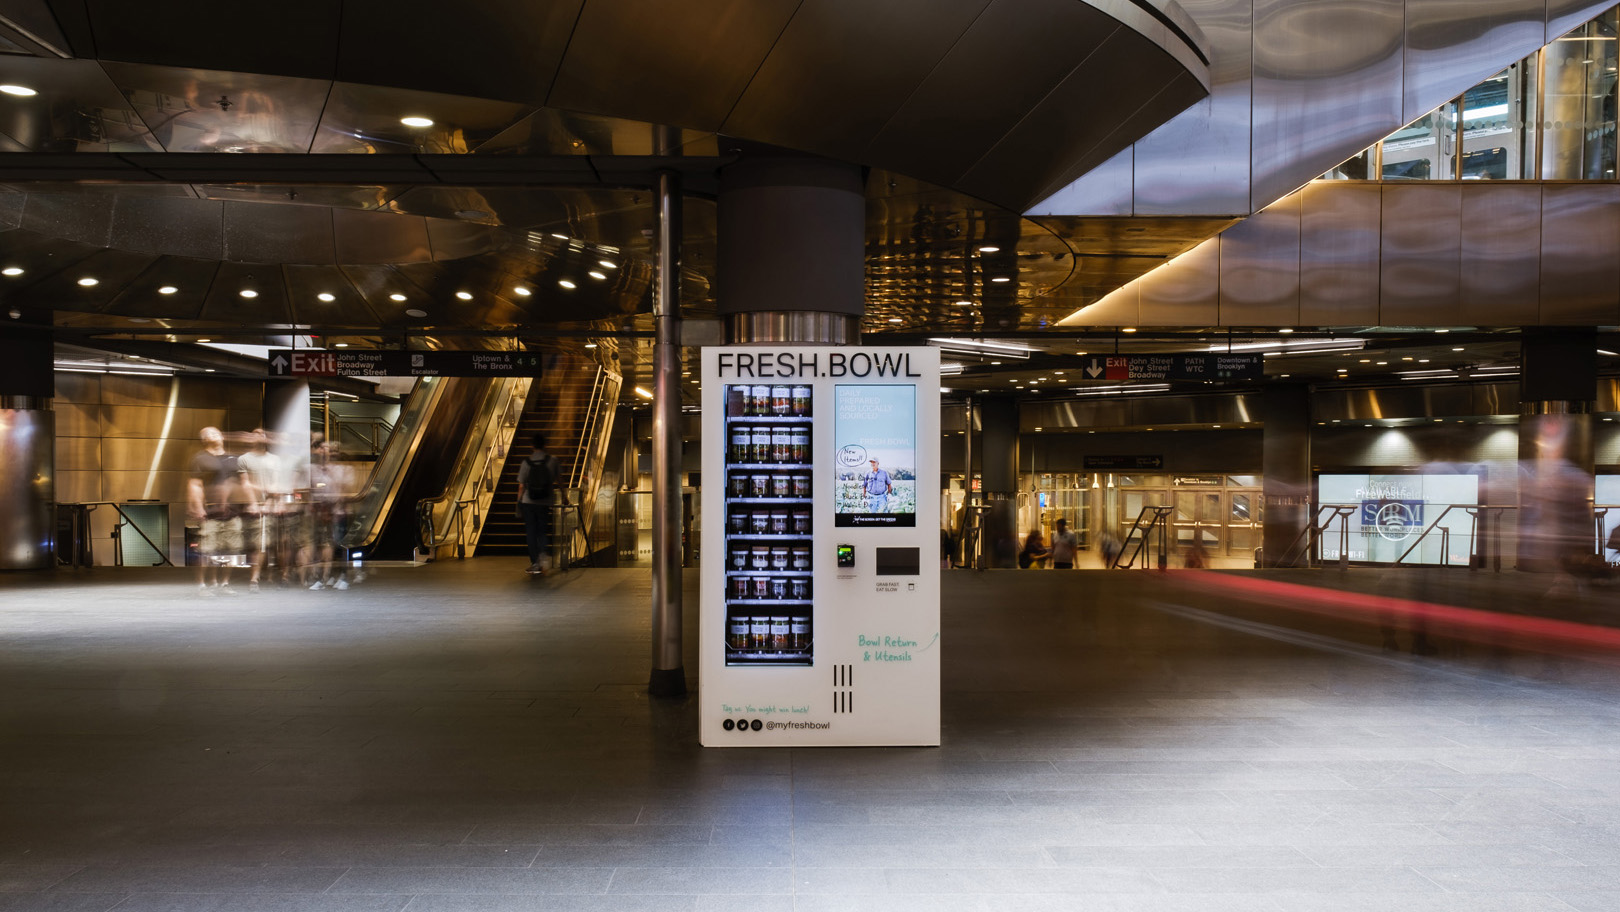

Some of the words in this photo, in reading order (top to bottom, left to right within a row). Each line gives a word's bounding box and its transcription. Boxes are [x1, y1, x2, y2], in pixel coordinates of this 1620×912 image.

[291, 353, 335, 373] Exit
[472, 355, 502, 364] Uptown
[1106, 358, 1127, 367] Exit
[337, 361, 375, 370] Broadway
[492, 362, 513, 370] Bronx
[717, 352, 922, 378] FRESH.BOWL
[840, 397, 881, 405] PREPARED
[840, 412, 878, 420] SOURCED
[859, 635, 880, 647] Bowl
[885, 636, 918, 647] Return
[864, 651, 870, 661] &
[875, 650, 912, 661] Utensils
[722, 704, 733, 713] Tag
[745, 705, 756, 713] You
[759, 705, 776, 714] might
[766, 721, 830, 730] @myfreshbowl
